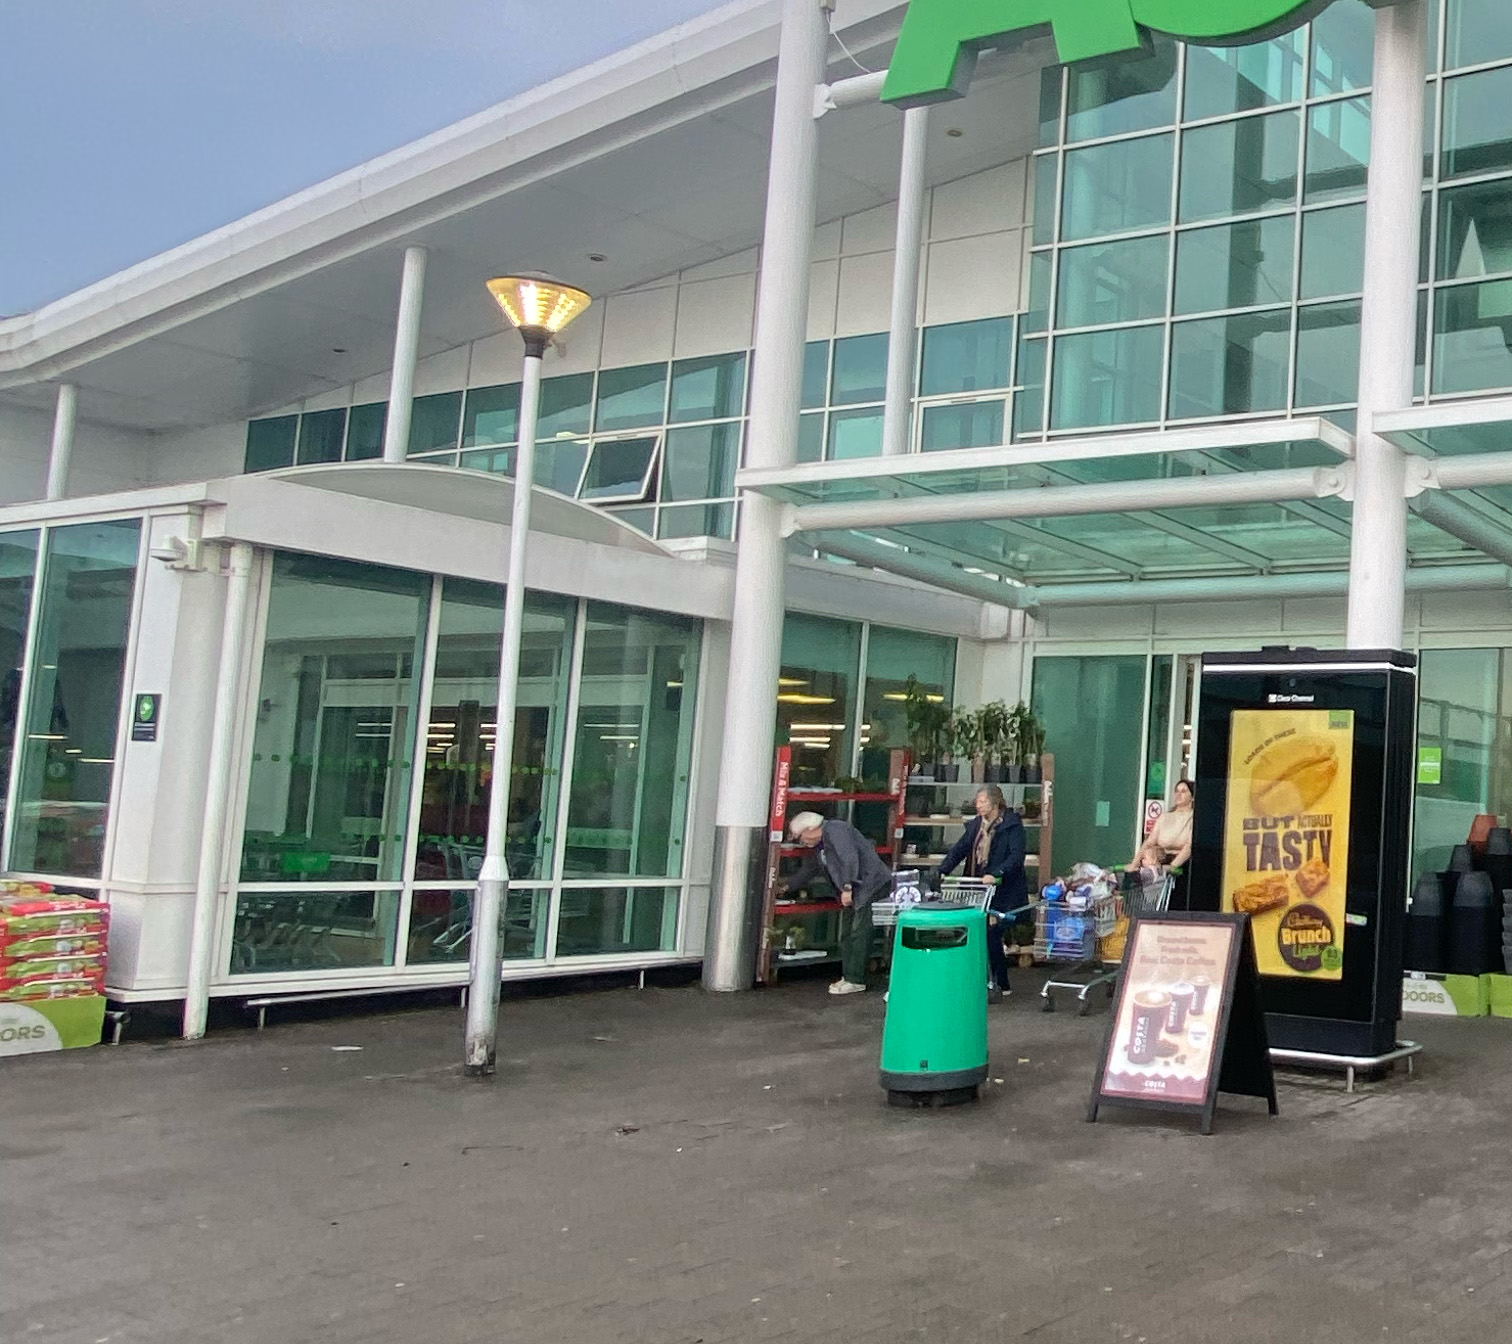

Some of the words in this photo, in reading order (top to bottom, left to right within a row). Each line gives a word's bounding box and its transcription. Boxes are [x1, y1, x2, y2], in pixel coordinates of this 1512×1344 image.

[775, 786, 786, 817] Match
[1243, 816, 1295, 830] BUT
[1297, 814, 1333, 829] ACTUALLY
[1243, 829, 1333, 872] TASTY
[1281, 925, 1332, 945] Brunch
